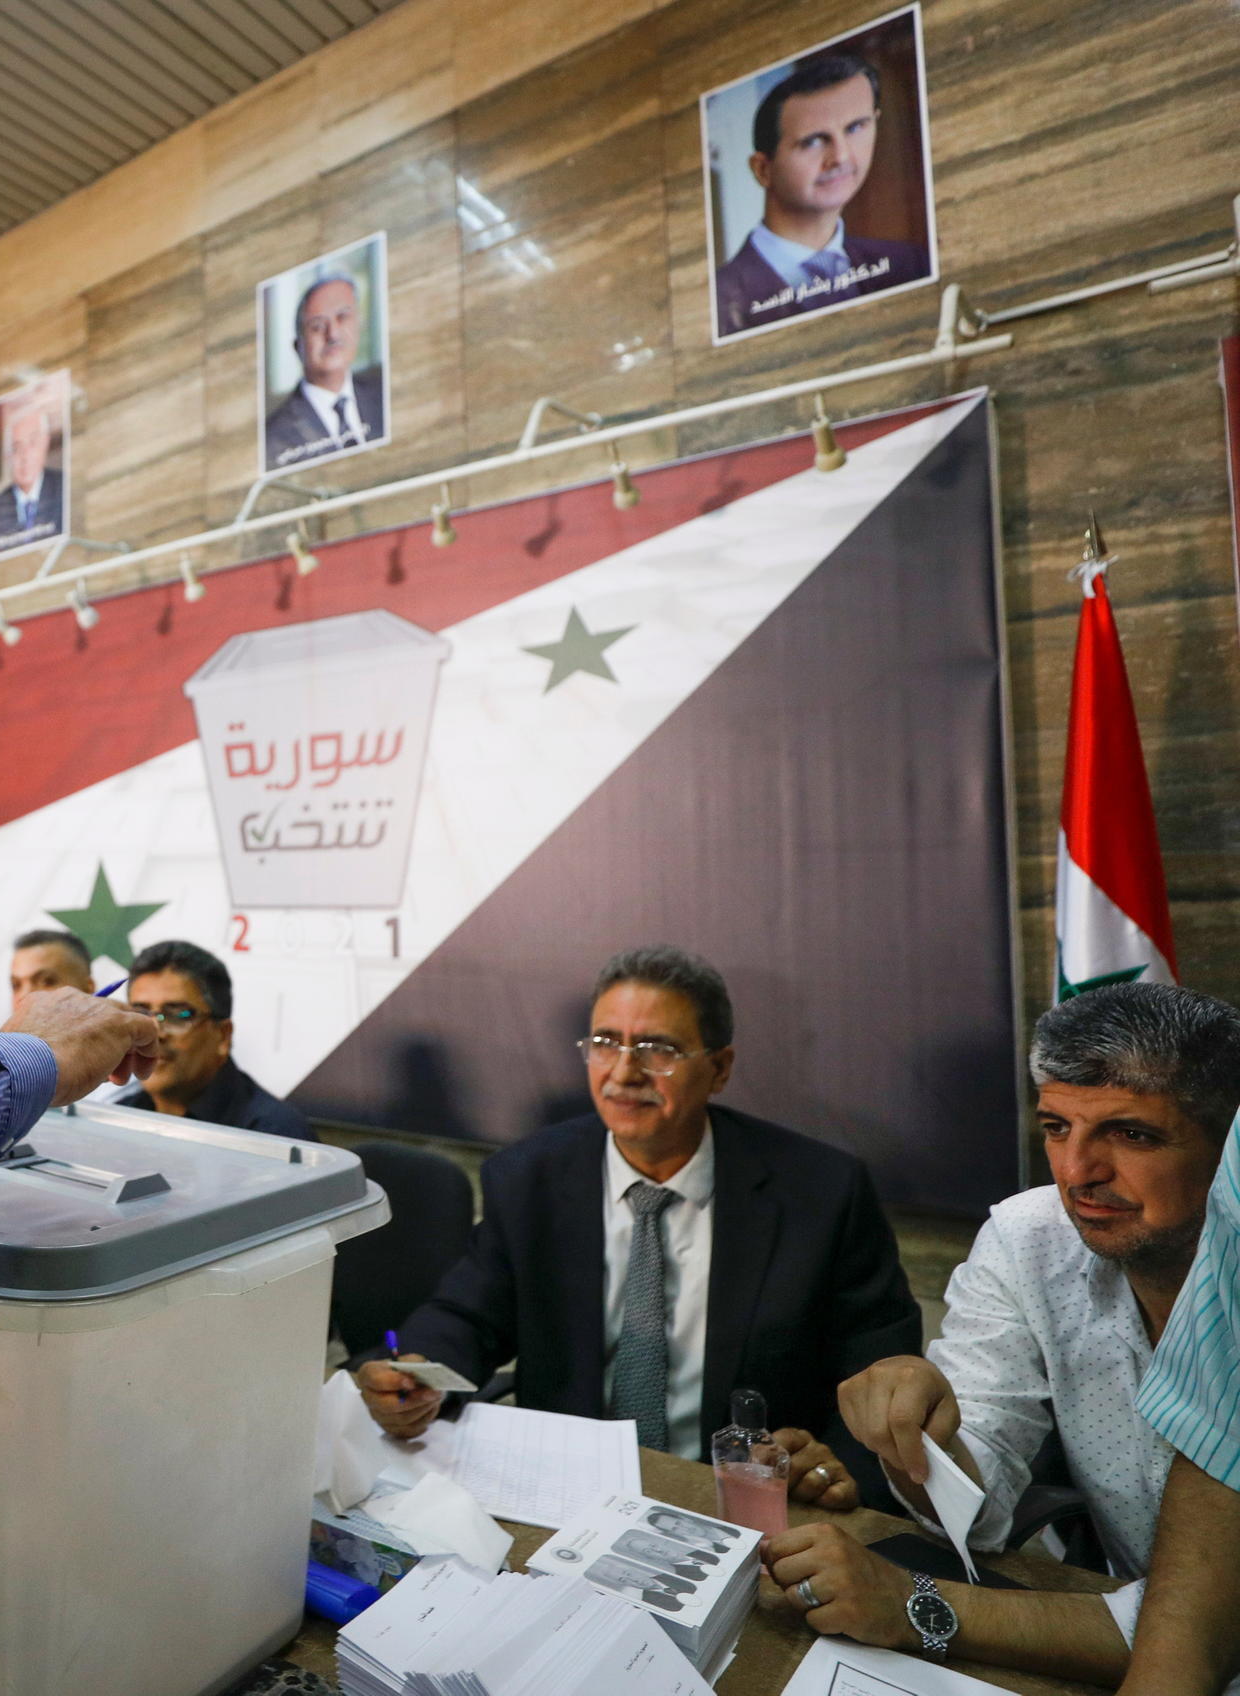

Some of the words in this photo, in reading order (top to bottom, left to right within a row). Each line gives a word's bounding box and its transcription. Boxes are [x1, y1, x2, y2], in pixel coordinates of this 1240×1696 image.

[796, 275, 831, 304] بشار
[224, 721, 406, 790] سورية
[240, 799, 395, 866] تنتخب
